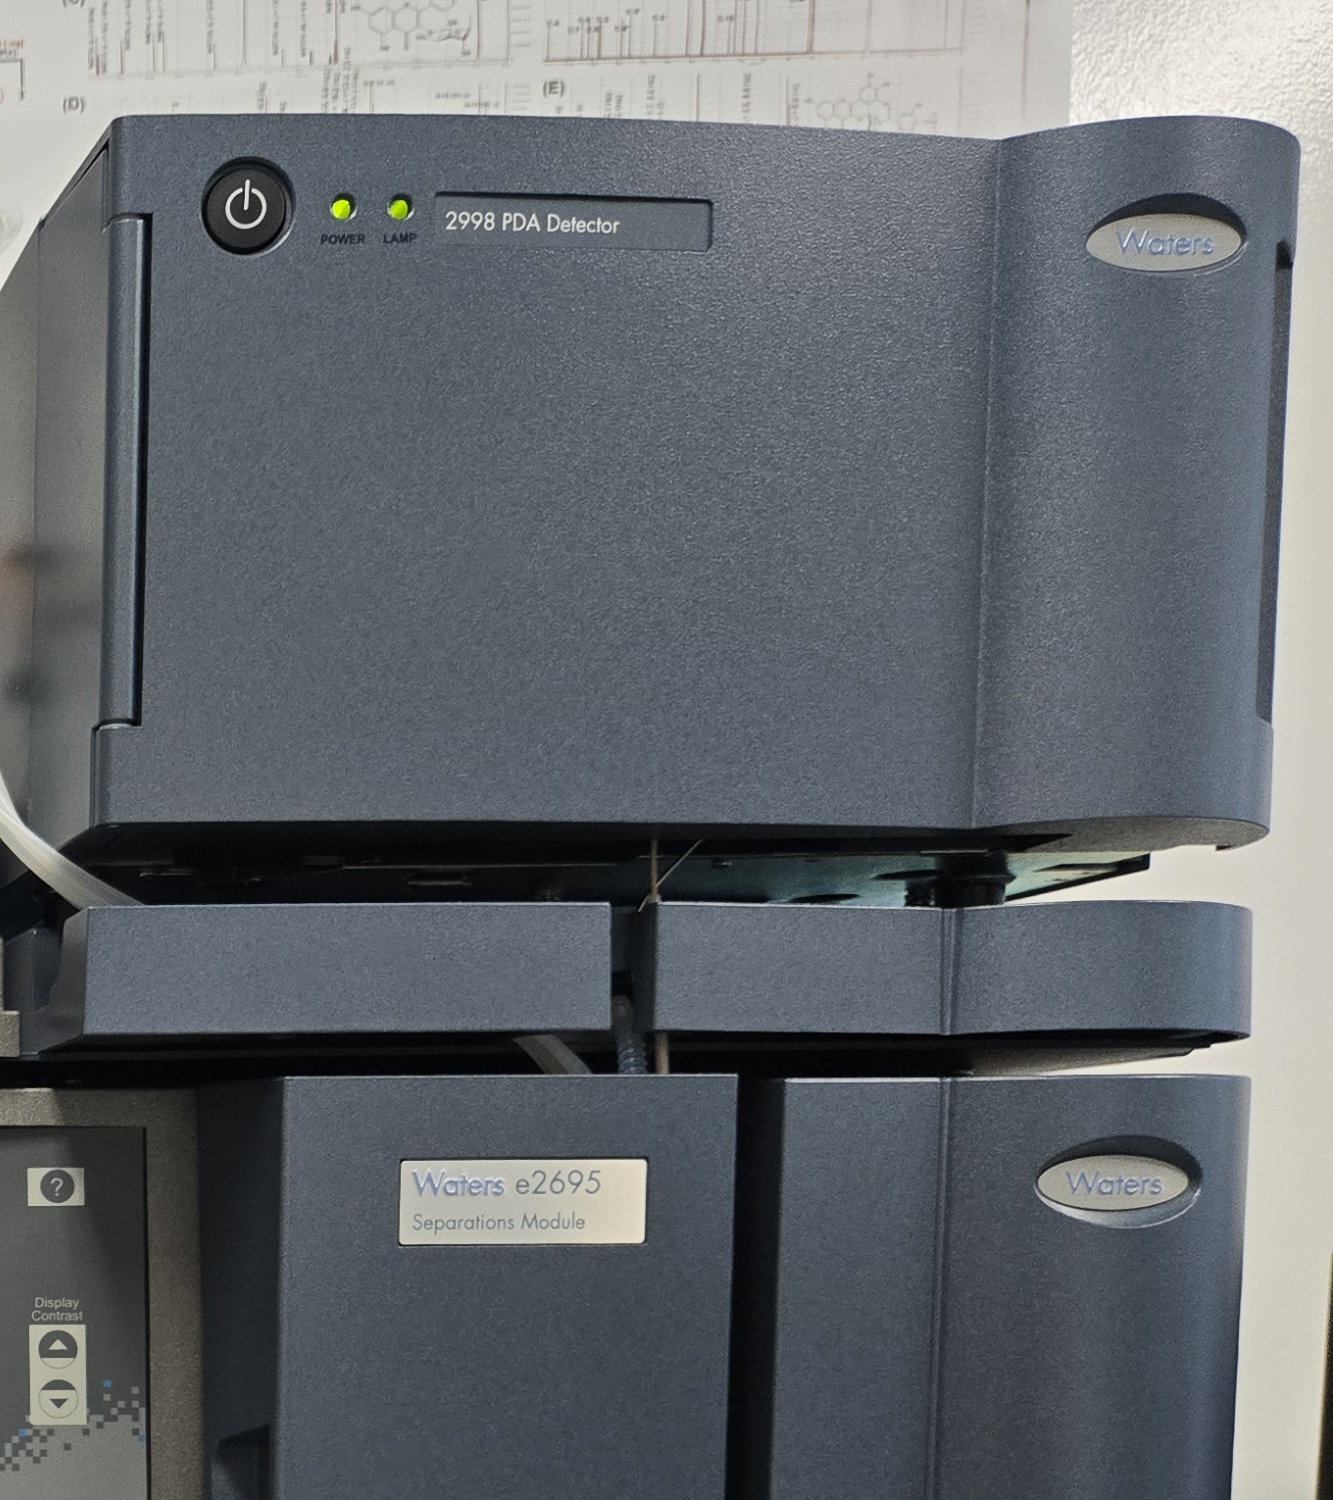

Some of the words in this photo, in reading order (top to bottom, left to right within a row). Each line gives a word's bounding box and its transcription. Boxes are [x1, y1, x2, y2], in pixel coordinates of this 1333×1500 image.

[445, 211, 496, 231] 2998
[502, 213, 541, 232] PDA
[547, 214, 620, 234] Detector
[320, 233, 366, 245] POWER
[383, 232, 418, 245] LAMP
[1115, 227, 1215, 256] Waters
[411, 1169, 505, 1197] Waters
[515, 1169, 602, 1195] e2695
[1066, 1170, 1162, 1195] Waters
[412, 1213, 515, 1235] Separations
[520, 1211, 586, 1230] Module
[34, 1297, 79, 1310] Display
[31, 1309, 83, 1322] Contrast
